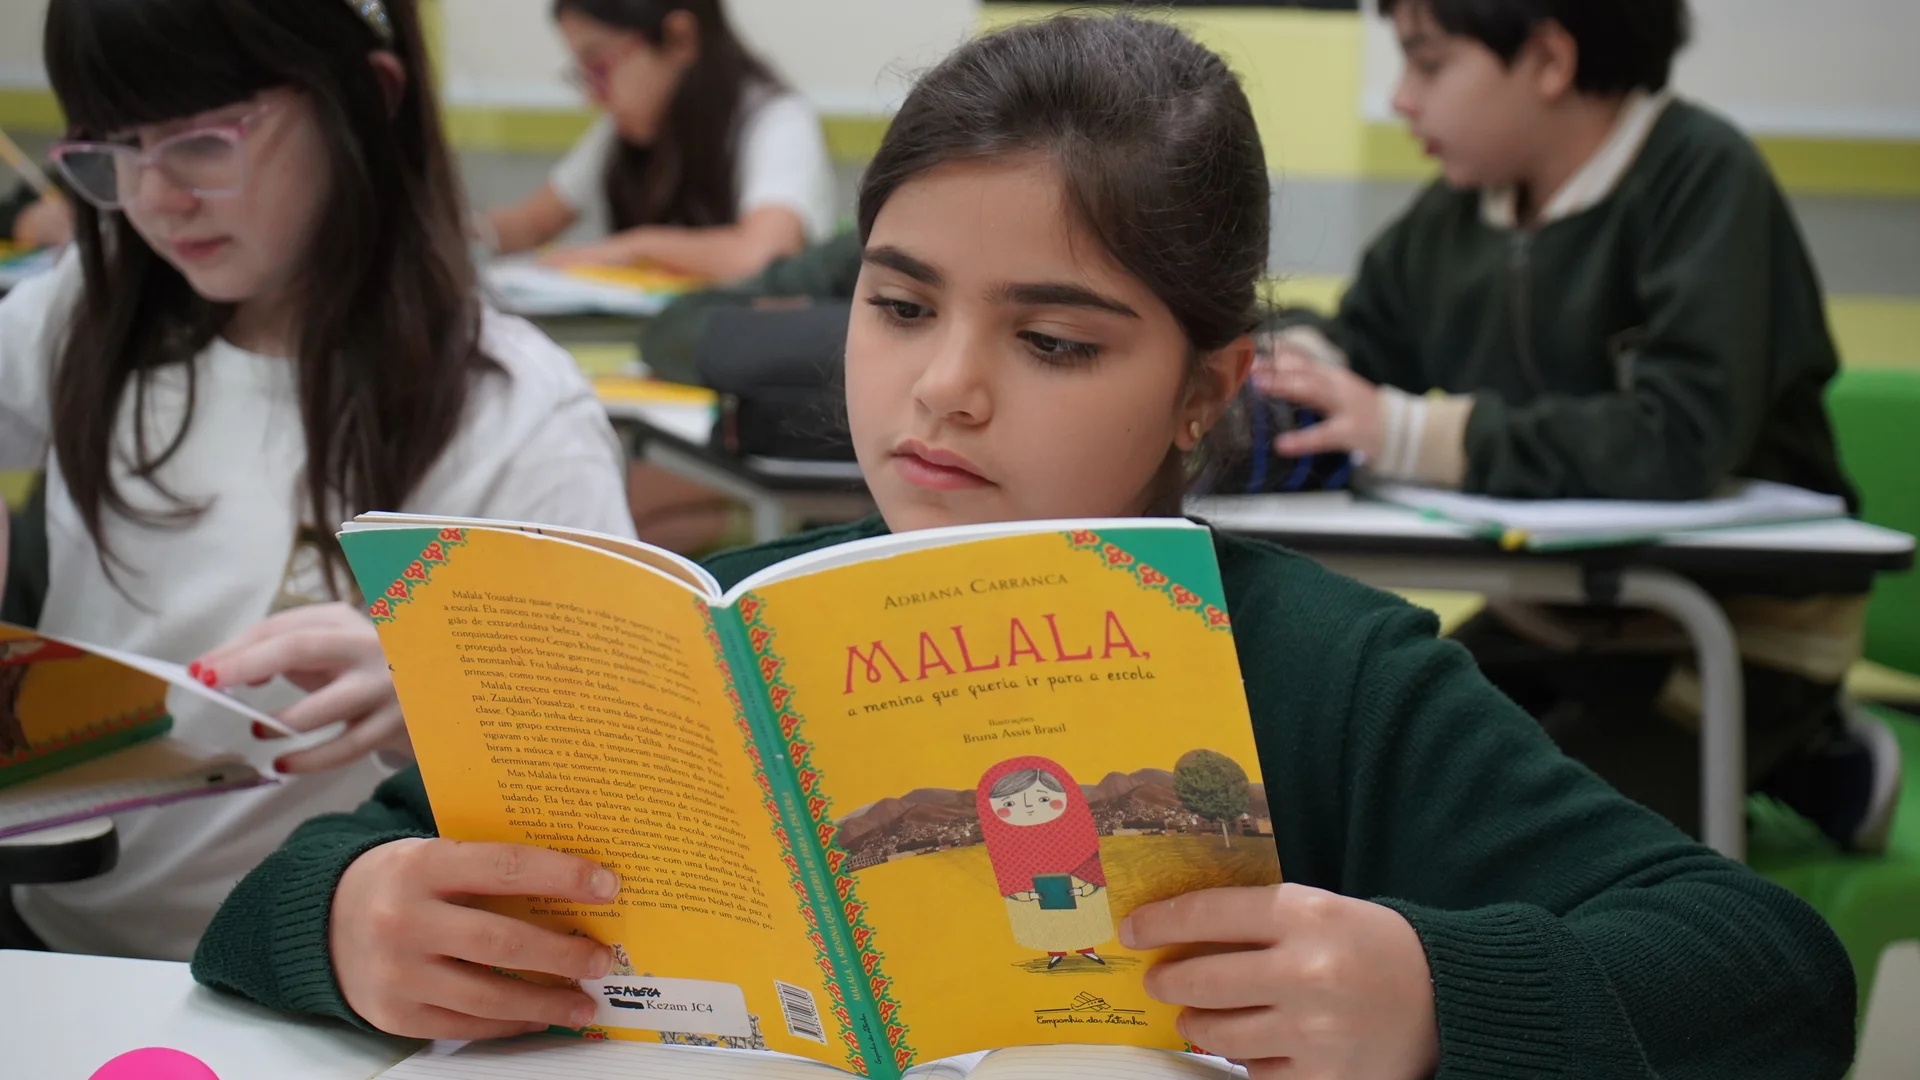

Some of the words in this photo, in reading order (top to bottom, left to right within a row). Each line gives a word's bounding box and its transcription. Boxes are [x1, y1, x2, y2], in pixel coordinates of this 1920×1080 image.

[452, 591, 482, 599] Malala
[485, 592, 526, 603] Yousafzai
[482, 604, 498, 613] Ela
[472, 617, 482, 625] de
[452, 631, 518, 640] conquistadores
[510, 646, 534, 655] pelos
[536, 648, 565, 658] bravos
[842, 609, 1150, 694] MALALA,
[460, 654, 474, 662] das
[530, 659, 544, 668] Foi
[546, 661, 583, 673] habitada
[586, 670, 600, 678] por
[480, 681, 512, 690] Malala
[585, 678, 595, 687] de
[848, 708, 858, 716] a
[864, 694, 924, 714] menina
[932, 687, 959, 706] que
[968, 678, 1020, 700] queria
[1024, 676, 1039, 686] ir
[1046, 674, 1084, 692] para
[1107, 665, 1156, 680] escola
[490, 694, 532, 704] Ziauddin
[624, 710, 637, 719] das
[506, 707, 542, 717] Quando
[544, 711, 566, 719] tinha
[568, 713, 582, 722] dez
[546, 726, 590, 734] extremista
[594, 729, 634, 741] chamado
[962, 730, 998, 744] Bruna
[1002, 728, 1030, 738] Assis
[1033, 723, 1066, 735] Brasil
[582, 739, 598, 748] dia,
[486, 743, 512, 752] biram
[574, 750, 602, 761] dança,
[604, 754, 638, 765] baniram
[490, 756, 550, 766] determinaram
[571, 764, 606, 772] somente
[620, 770, 656, 780] meninos
[528, 770, 557, 779] Malala
[560, 772, 570, 780] foi
[574, 776, 610, 784] ensinada
[612, 779, 636, 788] desde
[640, 785, 674, 795] pequena
[545, 785, 590, 794] acreditava
[600, 788, 623, 798] lutou
[626, 793, 644, 801] pelo
[502, 794, 542, 802] tudando.
[544, 795, 558, 803] Ela
[561, 796, 575, 805] fez
[596, 801, 631, 810] palavras
[676, 812, 691, 822] Em
[519, 806, 545, 816] 2012,
[584, 812, 616, 820] voltava
[620, 814, 630, 822] de
[634, 817, 663, 827] ônibus
[578, 822, 610, 831] Poucos
[612, 828, 662, 838] acreditaram
[682, 836, 694, 844] ela
[576, 834, 610, 843] Adriana
[612, 837, 650, 848] Carranca
[652, 844, 680, 853] visitou
[606, 848, 660, 860] hospedou-se
[620, 874, 653, 883] história
[674, 880, 696, 889] dessa
[699, 886, 728, 896] menina
[680, 872, 718, 883] aprendeu
[618, 884, 659, 895] anhadora
[676, 893, 706, 902] prêmio
[708, 897, 734, 908] Nobel
[530, 906, 549, 914] dem
[821, 905, 836, 923] QUE
[828, 926, 846, 958] MENINA
[646, 1000, 688, 1012] Kezam
[691, 1002, 714, 1013] JC4
[1036, 1014, 1084, 1028] Companhia
[1104, 1014, 1148, 1026] Letrinhas
